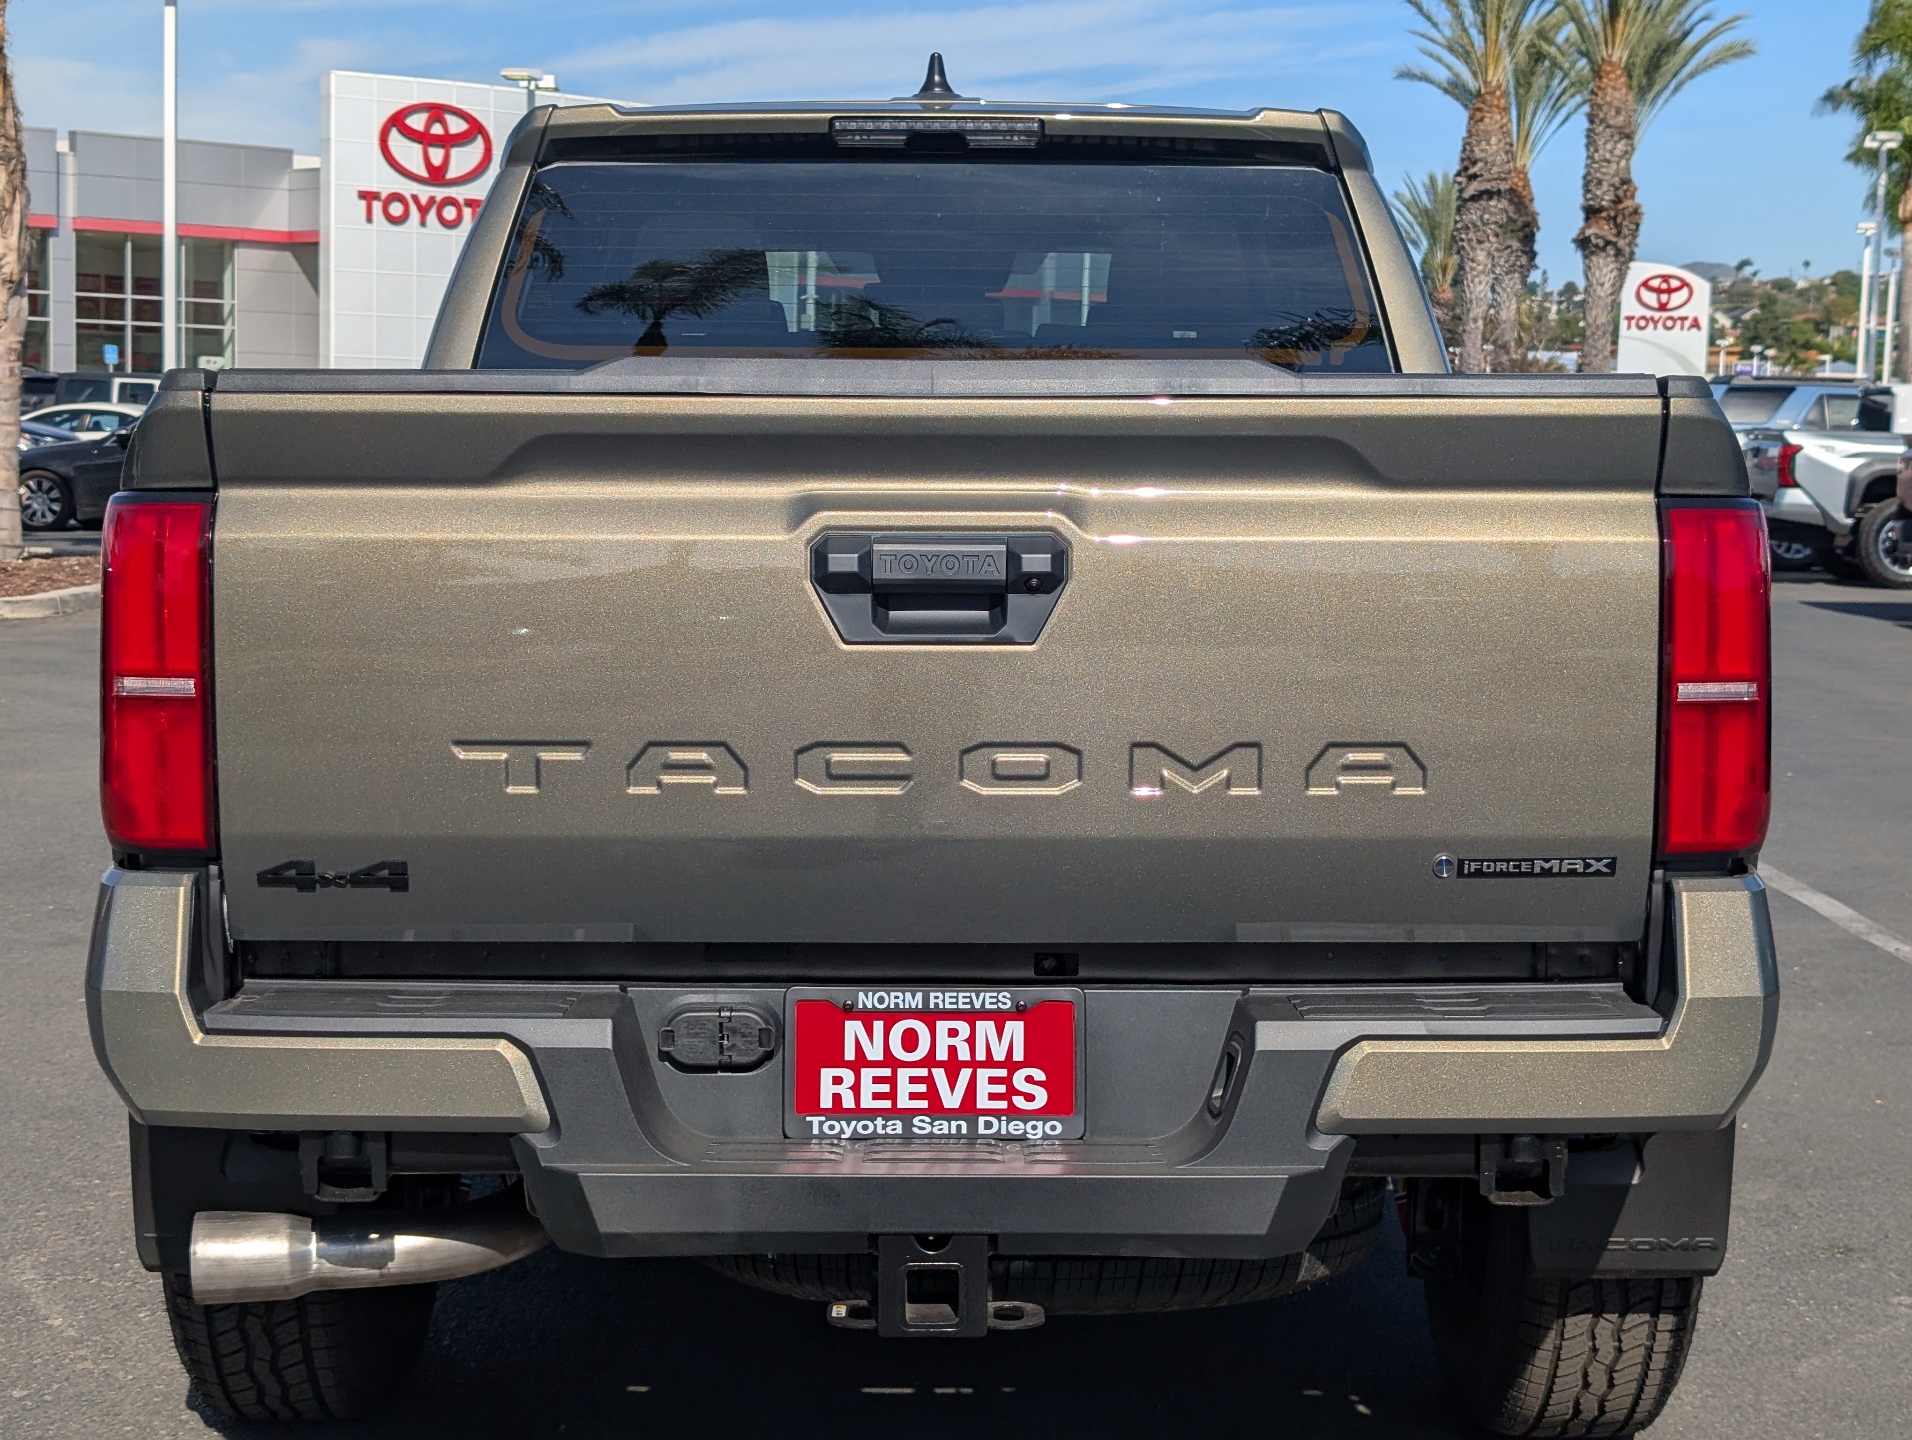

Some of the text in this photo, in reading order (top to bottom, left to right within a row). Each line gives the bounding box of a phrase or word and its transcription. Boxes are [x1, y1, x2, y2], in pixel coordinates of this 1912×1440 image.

[357, 190, 484, 228] TOYOT
[1624, 315, 1702, 331] TOYOTA
[880, 553, 1001, 575] TOYOTA
[450, 739, 1427, 795] TACOMA
[857, 991, 1012, 1009] NORM REEVES
[843, 1019, 1025, 1062] NORM
[819, 1067, 1049, 1110] REEVES
[806, 1116, 1063, 1139] Toyota San Diego
[1549, 1236, 1717, 1251] COMA
